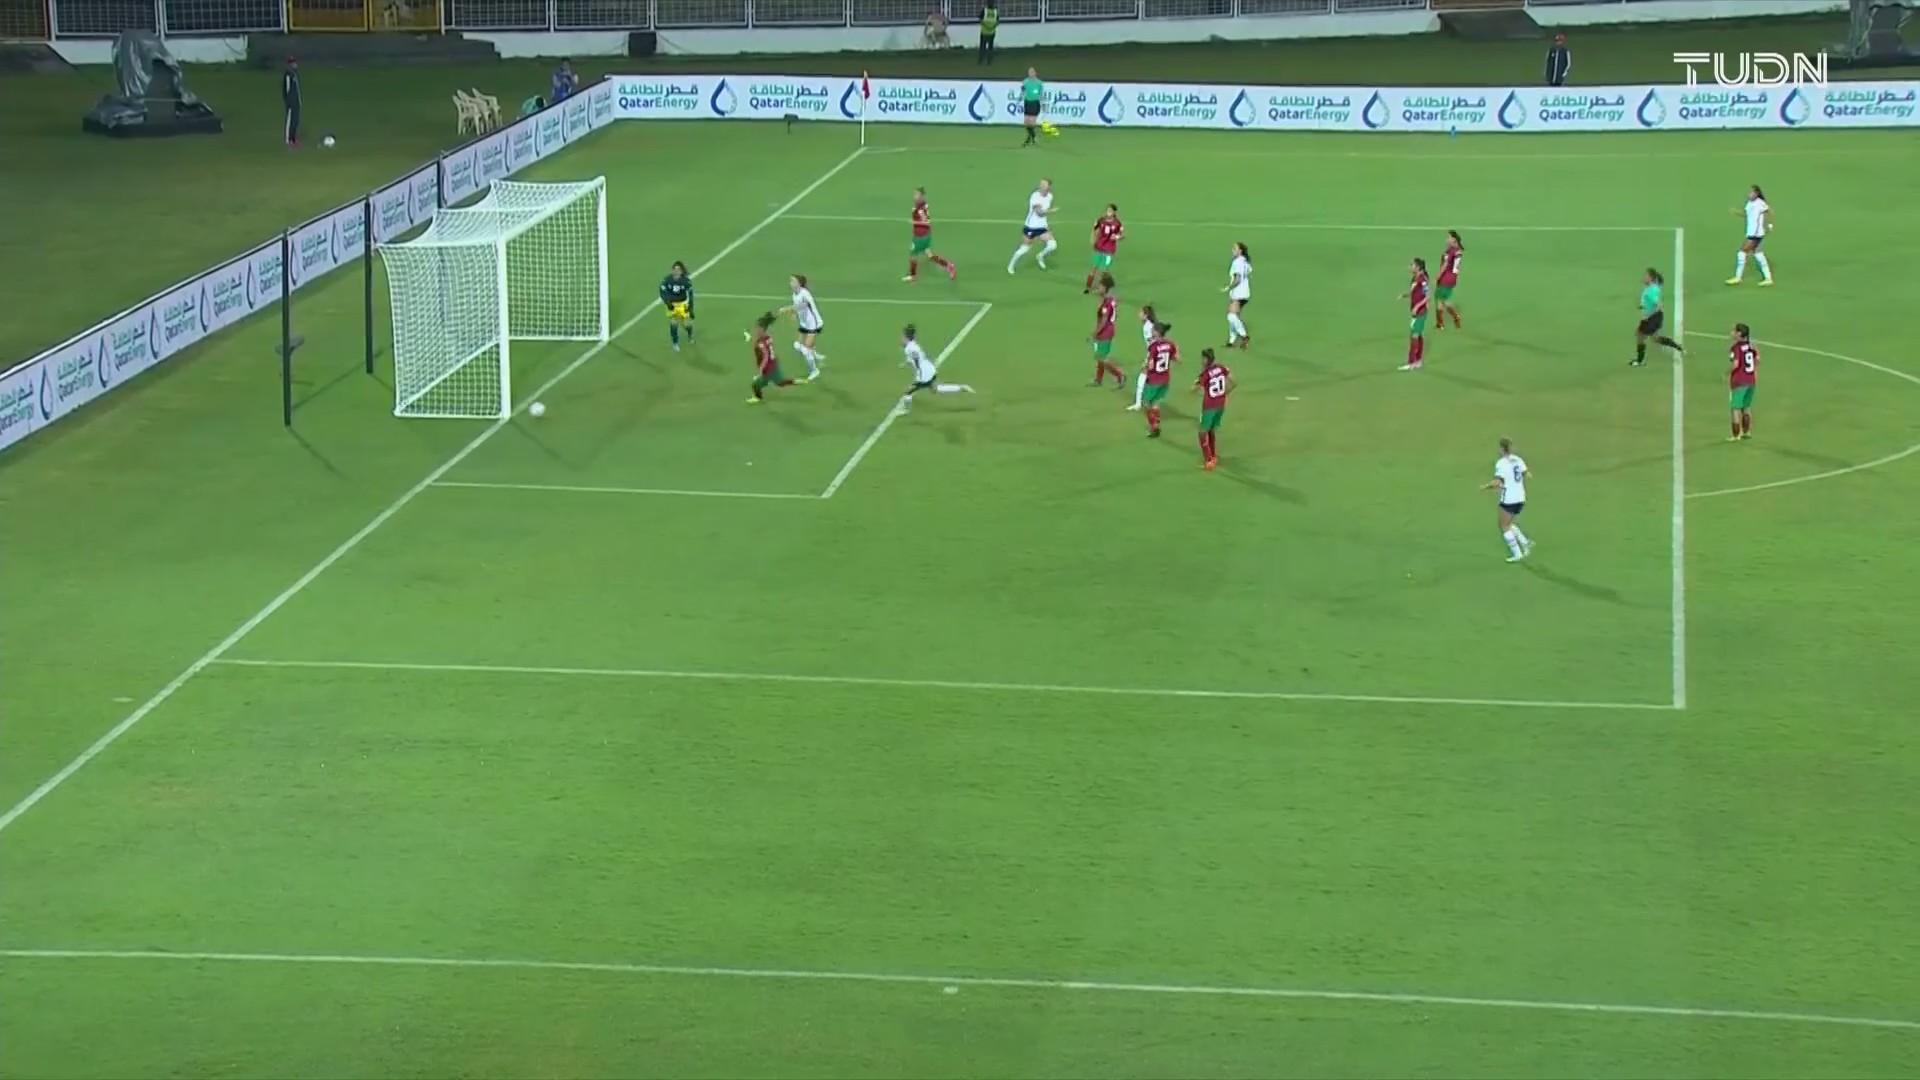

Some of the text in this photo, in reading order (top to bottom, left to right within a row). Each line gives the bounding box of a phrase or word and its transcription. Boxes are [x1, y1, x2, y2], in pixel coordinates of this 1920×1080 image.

[618, 97, 699, 110] QatarEnergy
[748, 97, 829, 112] QatarEnergy
[877, 101, 957, 114] QatarEnergy
[1136, 105, 1218, 120] QatarEnergy
[1268, 108, 1351, 122] QatarEnergy
[1401, 109, 1487, 122] QatarEnergy
[1539, 109, 1626, 121] QatarEnergy
[1678, 105, 1769, 120] QatarEnergy
[1822, 104, 1917, 117] QatarEnergy
[1745, 350, 1754, 373] 9
